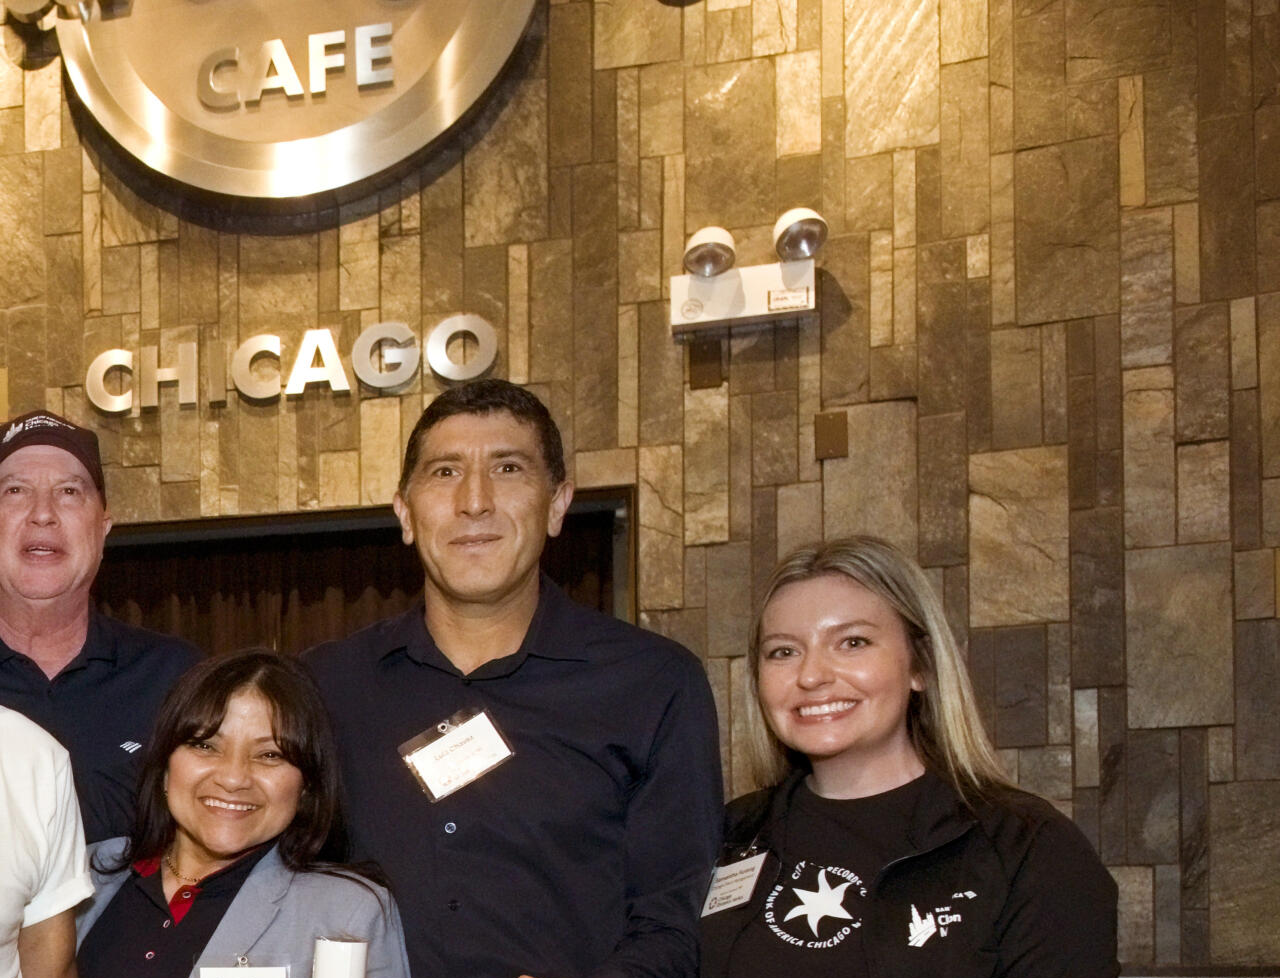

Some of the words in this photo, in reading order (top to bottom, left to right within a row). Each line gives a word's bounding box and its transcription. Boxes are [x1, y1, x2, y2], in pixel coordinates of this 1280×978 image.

[197, 21, 395, 113] CAFE
[85, 313, 498, 415] CHICAGO
[765, 884, 784, 909] BANK
[765, 911, 776, 923] OF
[806, 926, 851, 949] CHICAGO
